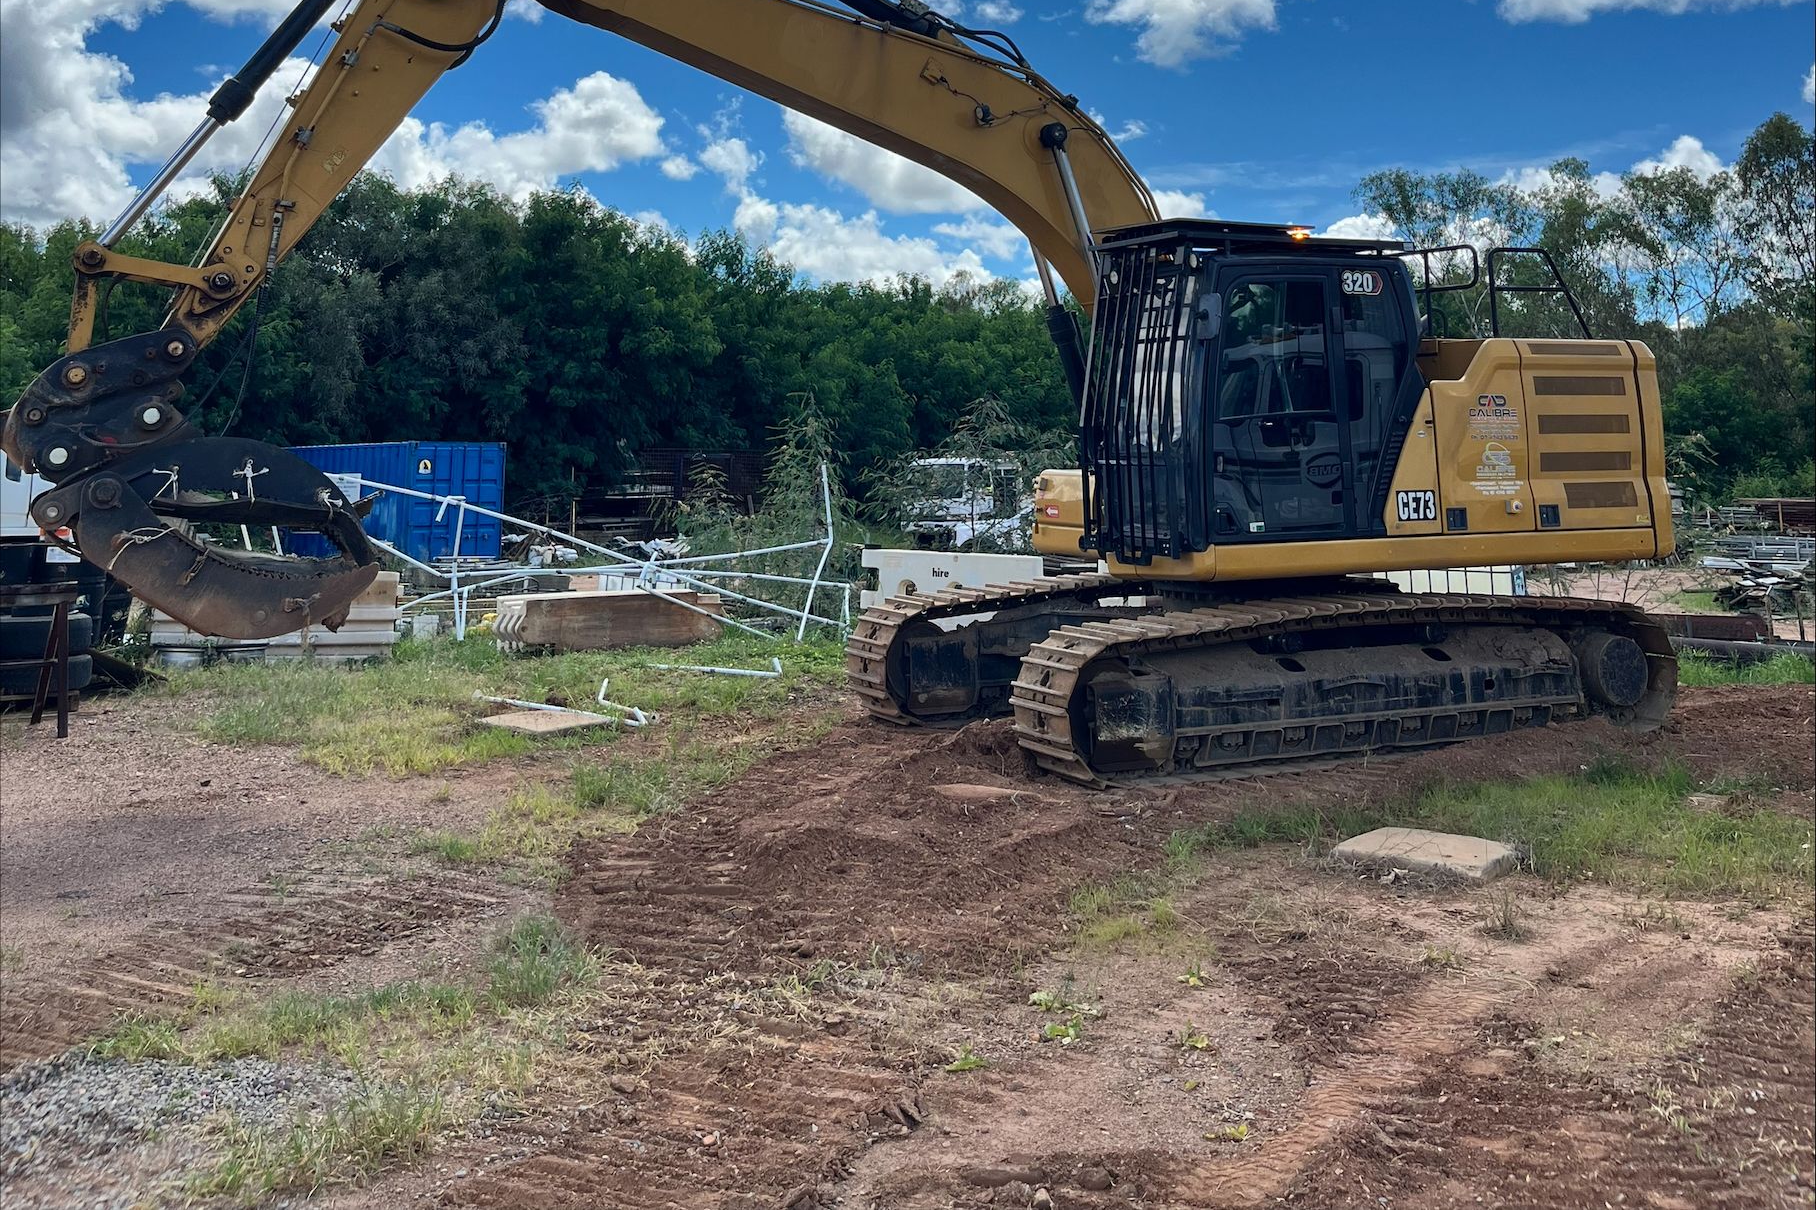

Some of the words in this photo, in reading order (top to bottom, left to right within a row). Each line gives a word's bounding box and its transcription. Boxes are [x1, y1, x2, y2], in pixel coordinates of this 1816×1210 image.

[1343, 272, 1373, 293] 320
[1469, 408, 1518, 417] CALIBRE
[1397, 491, 1436, 520] CE73
[932, 567, 950, 578] hire
